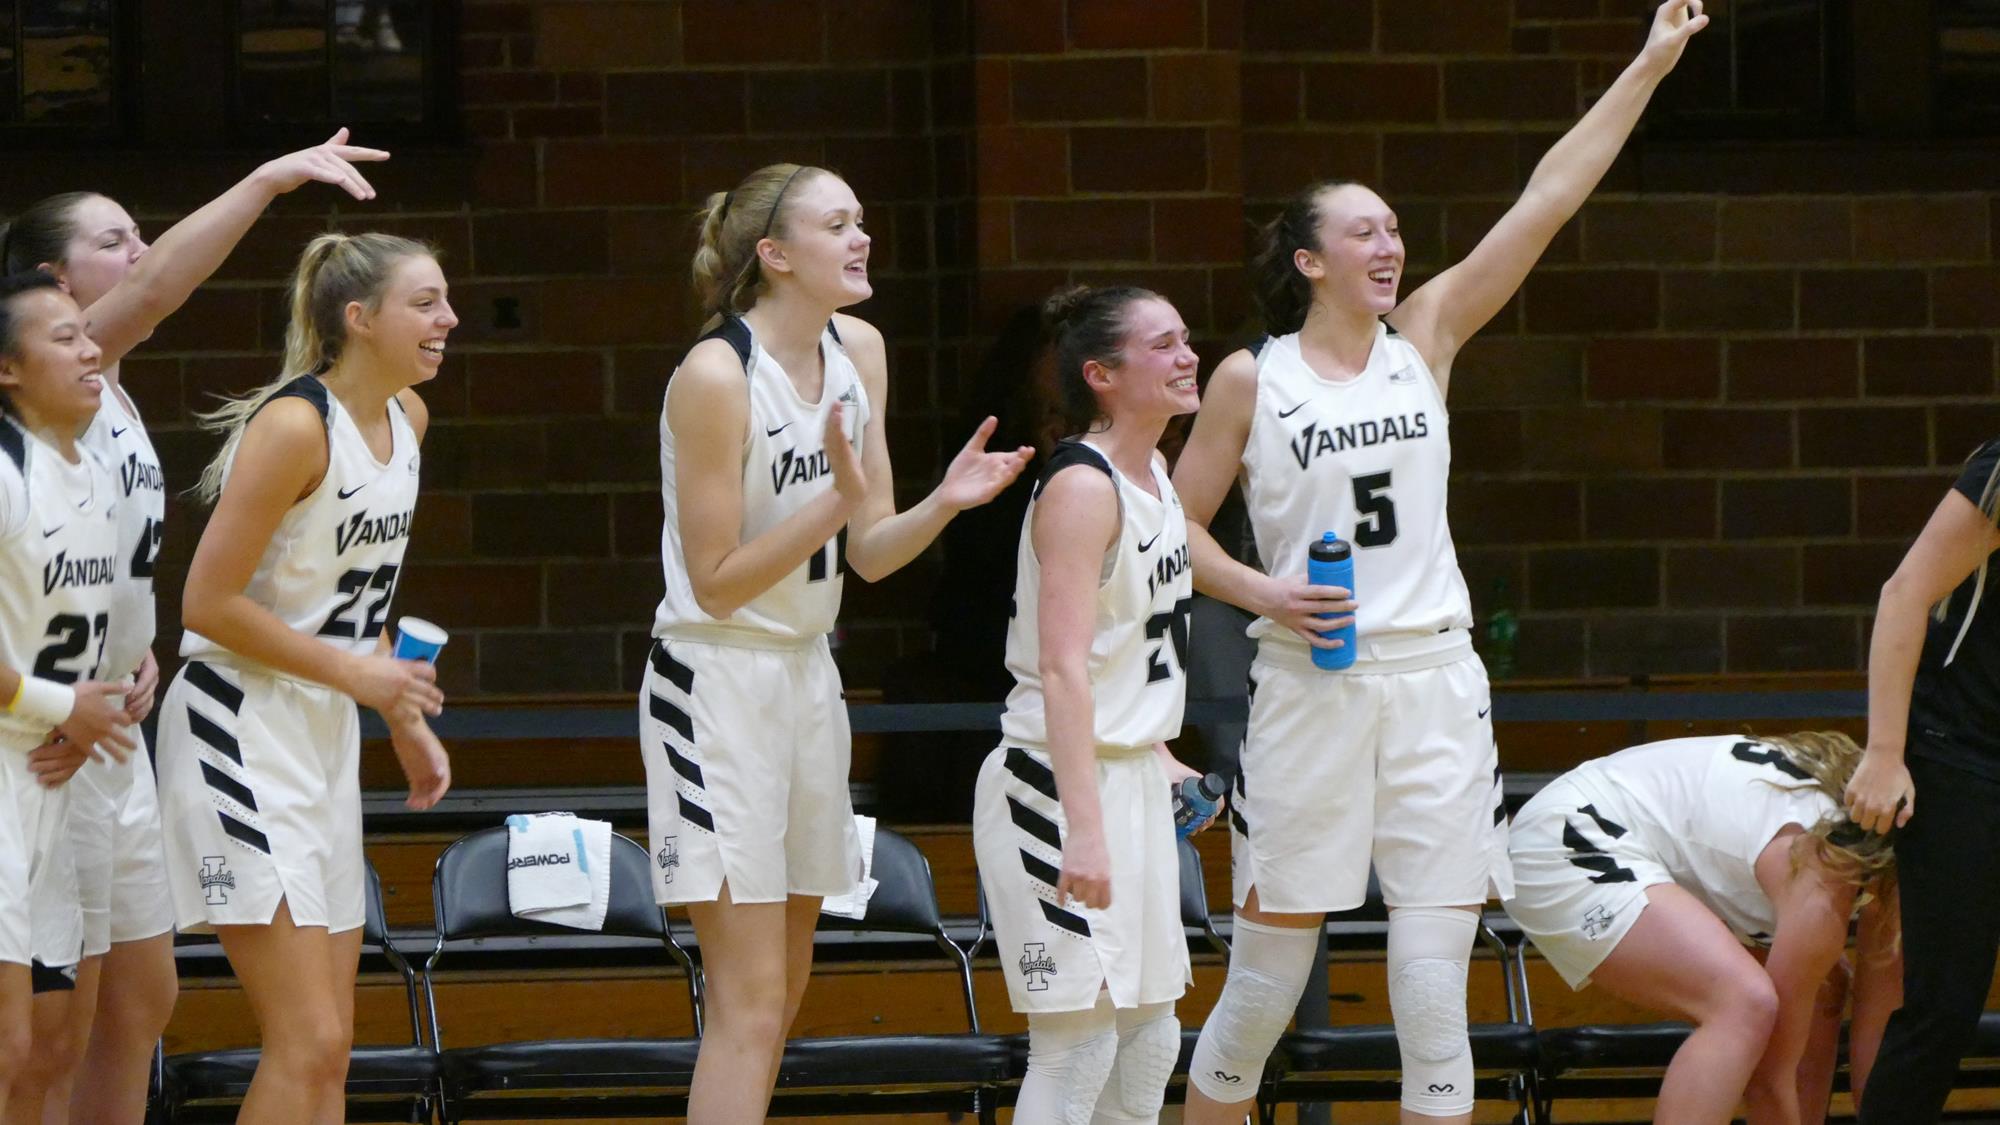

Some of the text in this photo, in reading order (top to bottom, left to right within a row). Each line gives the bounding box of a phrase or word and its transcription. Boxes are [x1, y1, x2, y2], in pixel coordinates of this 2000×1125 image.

[1290, 411, 1428, 471] VANDALS
[1351, 468, 1400, 550] 5
[316, 561, 400, 640] 22
